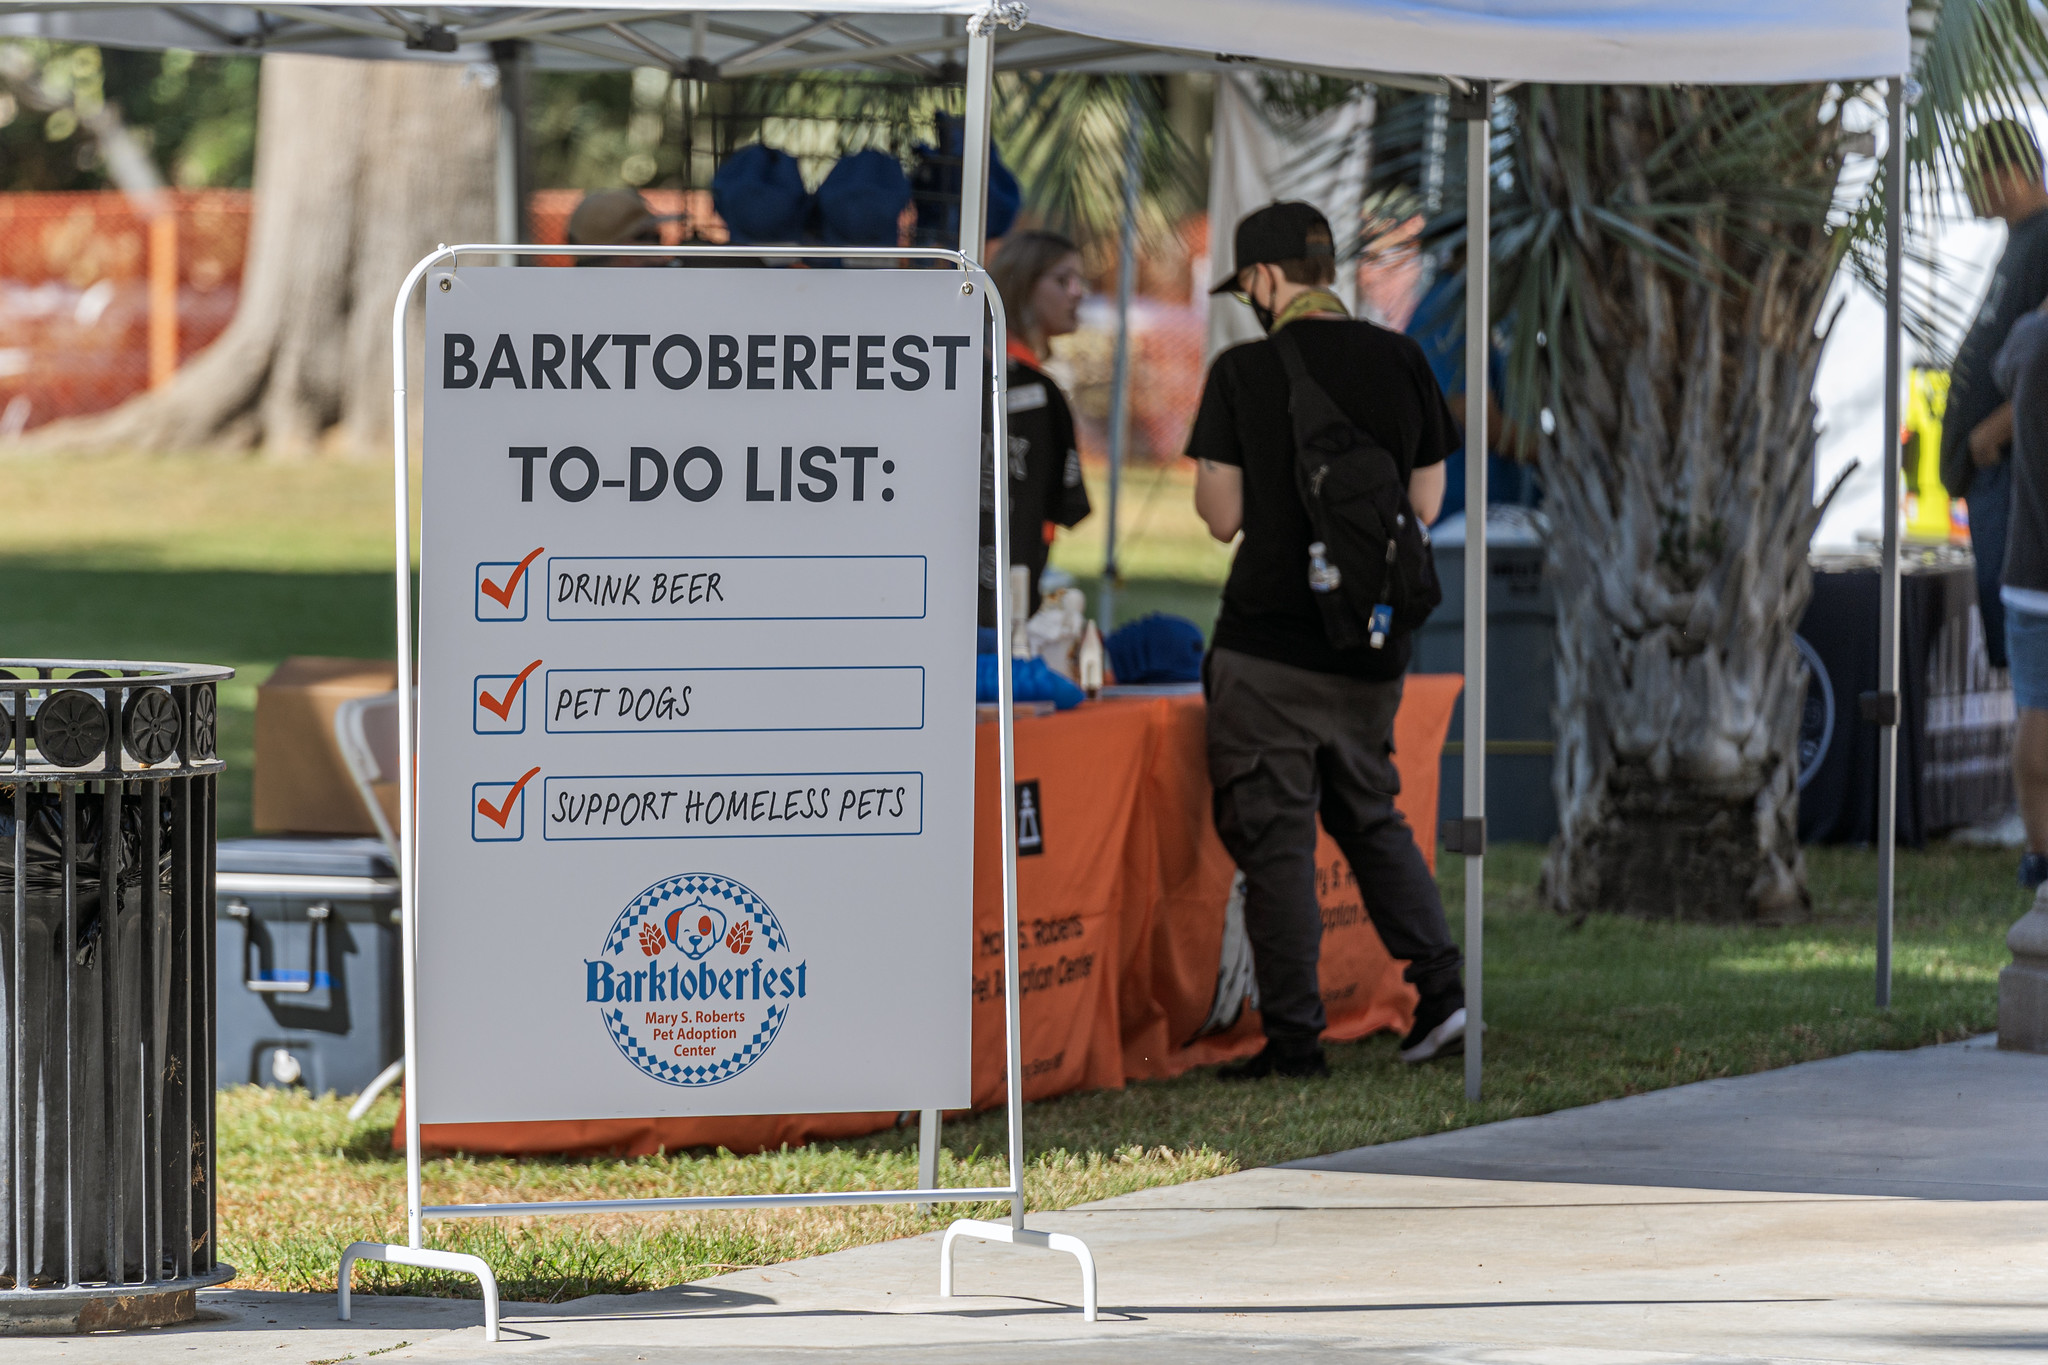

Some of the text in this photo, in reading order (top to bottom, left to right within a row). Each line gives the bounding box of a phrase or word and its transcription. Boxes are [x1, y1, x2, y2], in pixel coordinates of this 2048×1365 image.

[443, 333, 970, 391] BARKTOBERFEST
[509, 446, 895, 502] TO-DO LIST:
[558, 573, 723, 606] DRINK BEER
[555, 686, 691, 721] PET DOGS
[552, 787, 905, 826] SUPPORT HOMELESS PETS
[584, 958, 807, 1003] Barktoberfest
[645, 1010, 745, 1027] Mary S. Roberts
[653, 1027, 737, 1042] Pet Adoption
[674, 1044, 716, 1057] Center
